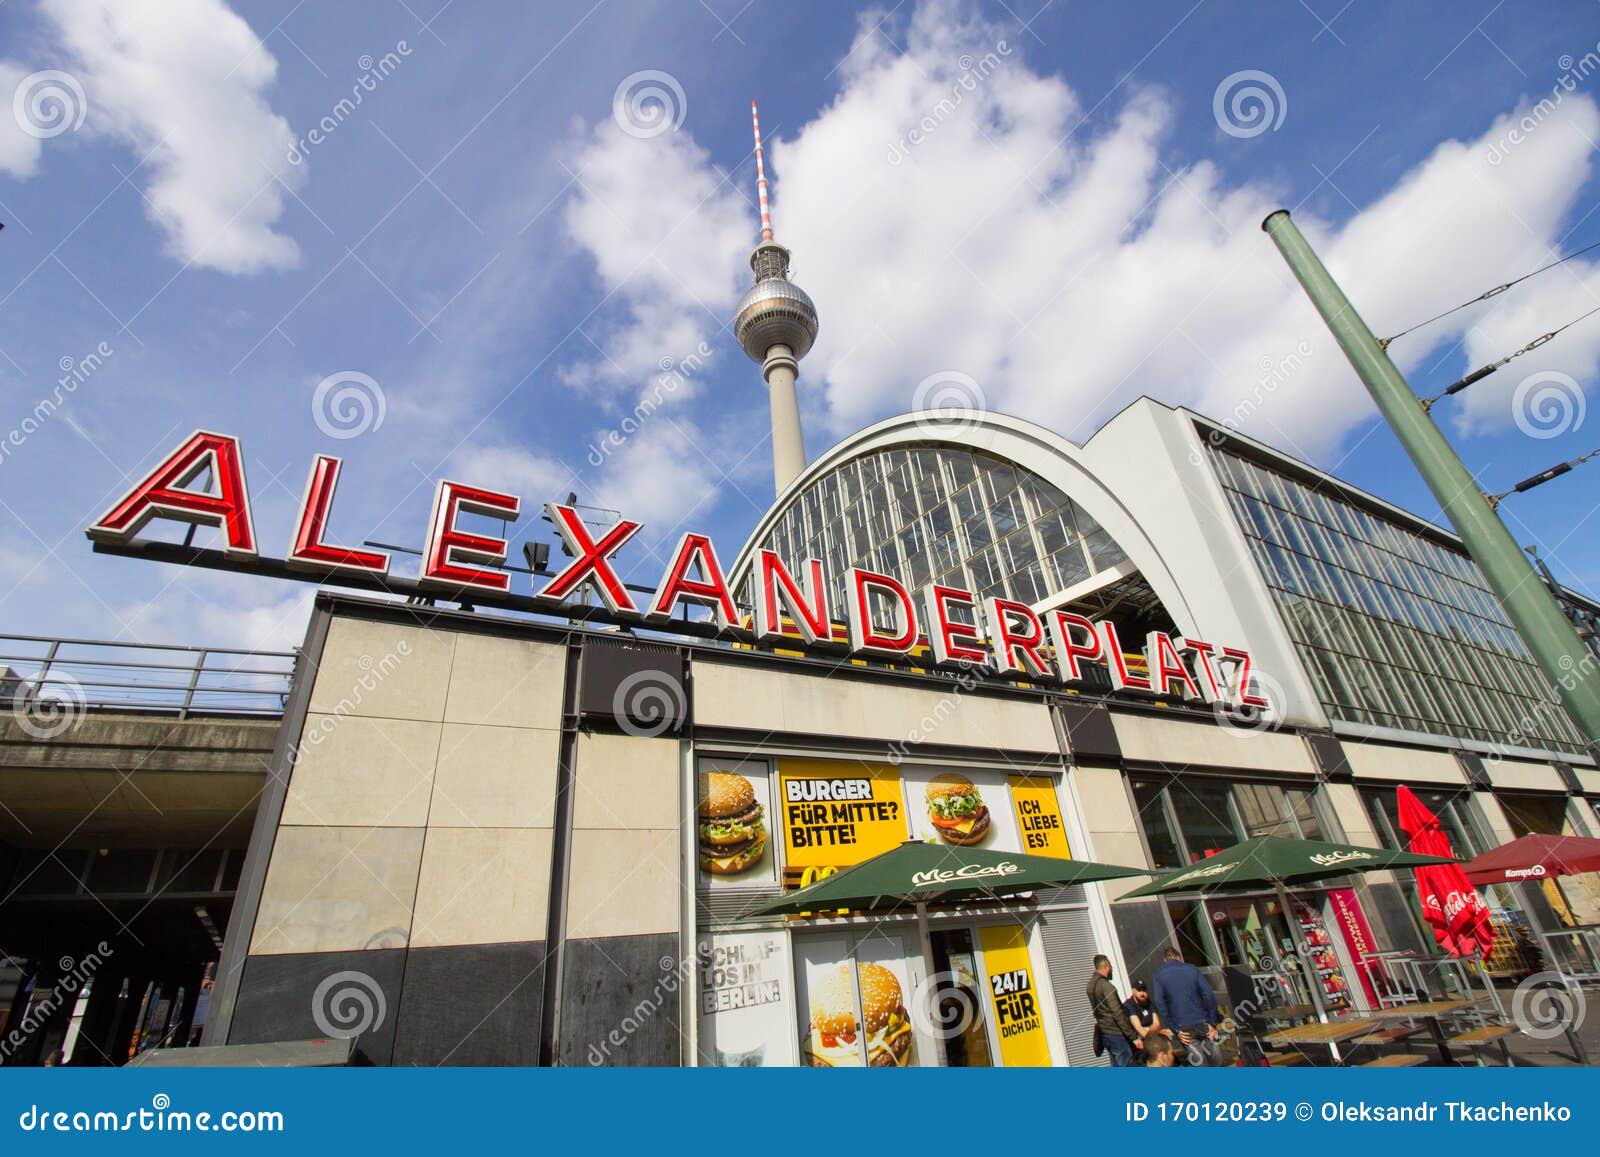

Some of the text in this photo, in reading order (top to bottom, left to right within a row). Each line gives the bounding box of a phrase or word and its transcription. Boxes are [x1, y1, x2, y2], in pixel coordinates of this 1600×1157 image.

[85, 429, 1271, 711] ALEXANDERPLATZ
[786, 779, 872, 801] BURGER
[831, 802, 898, 823] MITTE?
[1018, 800, 1041, 815] ICH
[1022, 815, 1059, 831] LIEBE
[791, 824, 856, 848] BITTE!
[1027, 833, 1049, 848] ES!
[701, 966, 739, 990] LOS
[992, 969, 1027, 996] 24/7
[704, 981, 779, 1014] BERLIN!
[1002, 1018, 1041, 1038] DICH DA!
